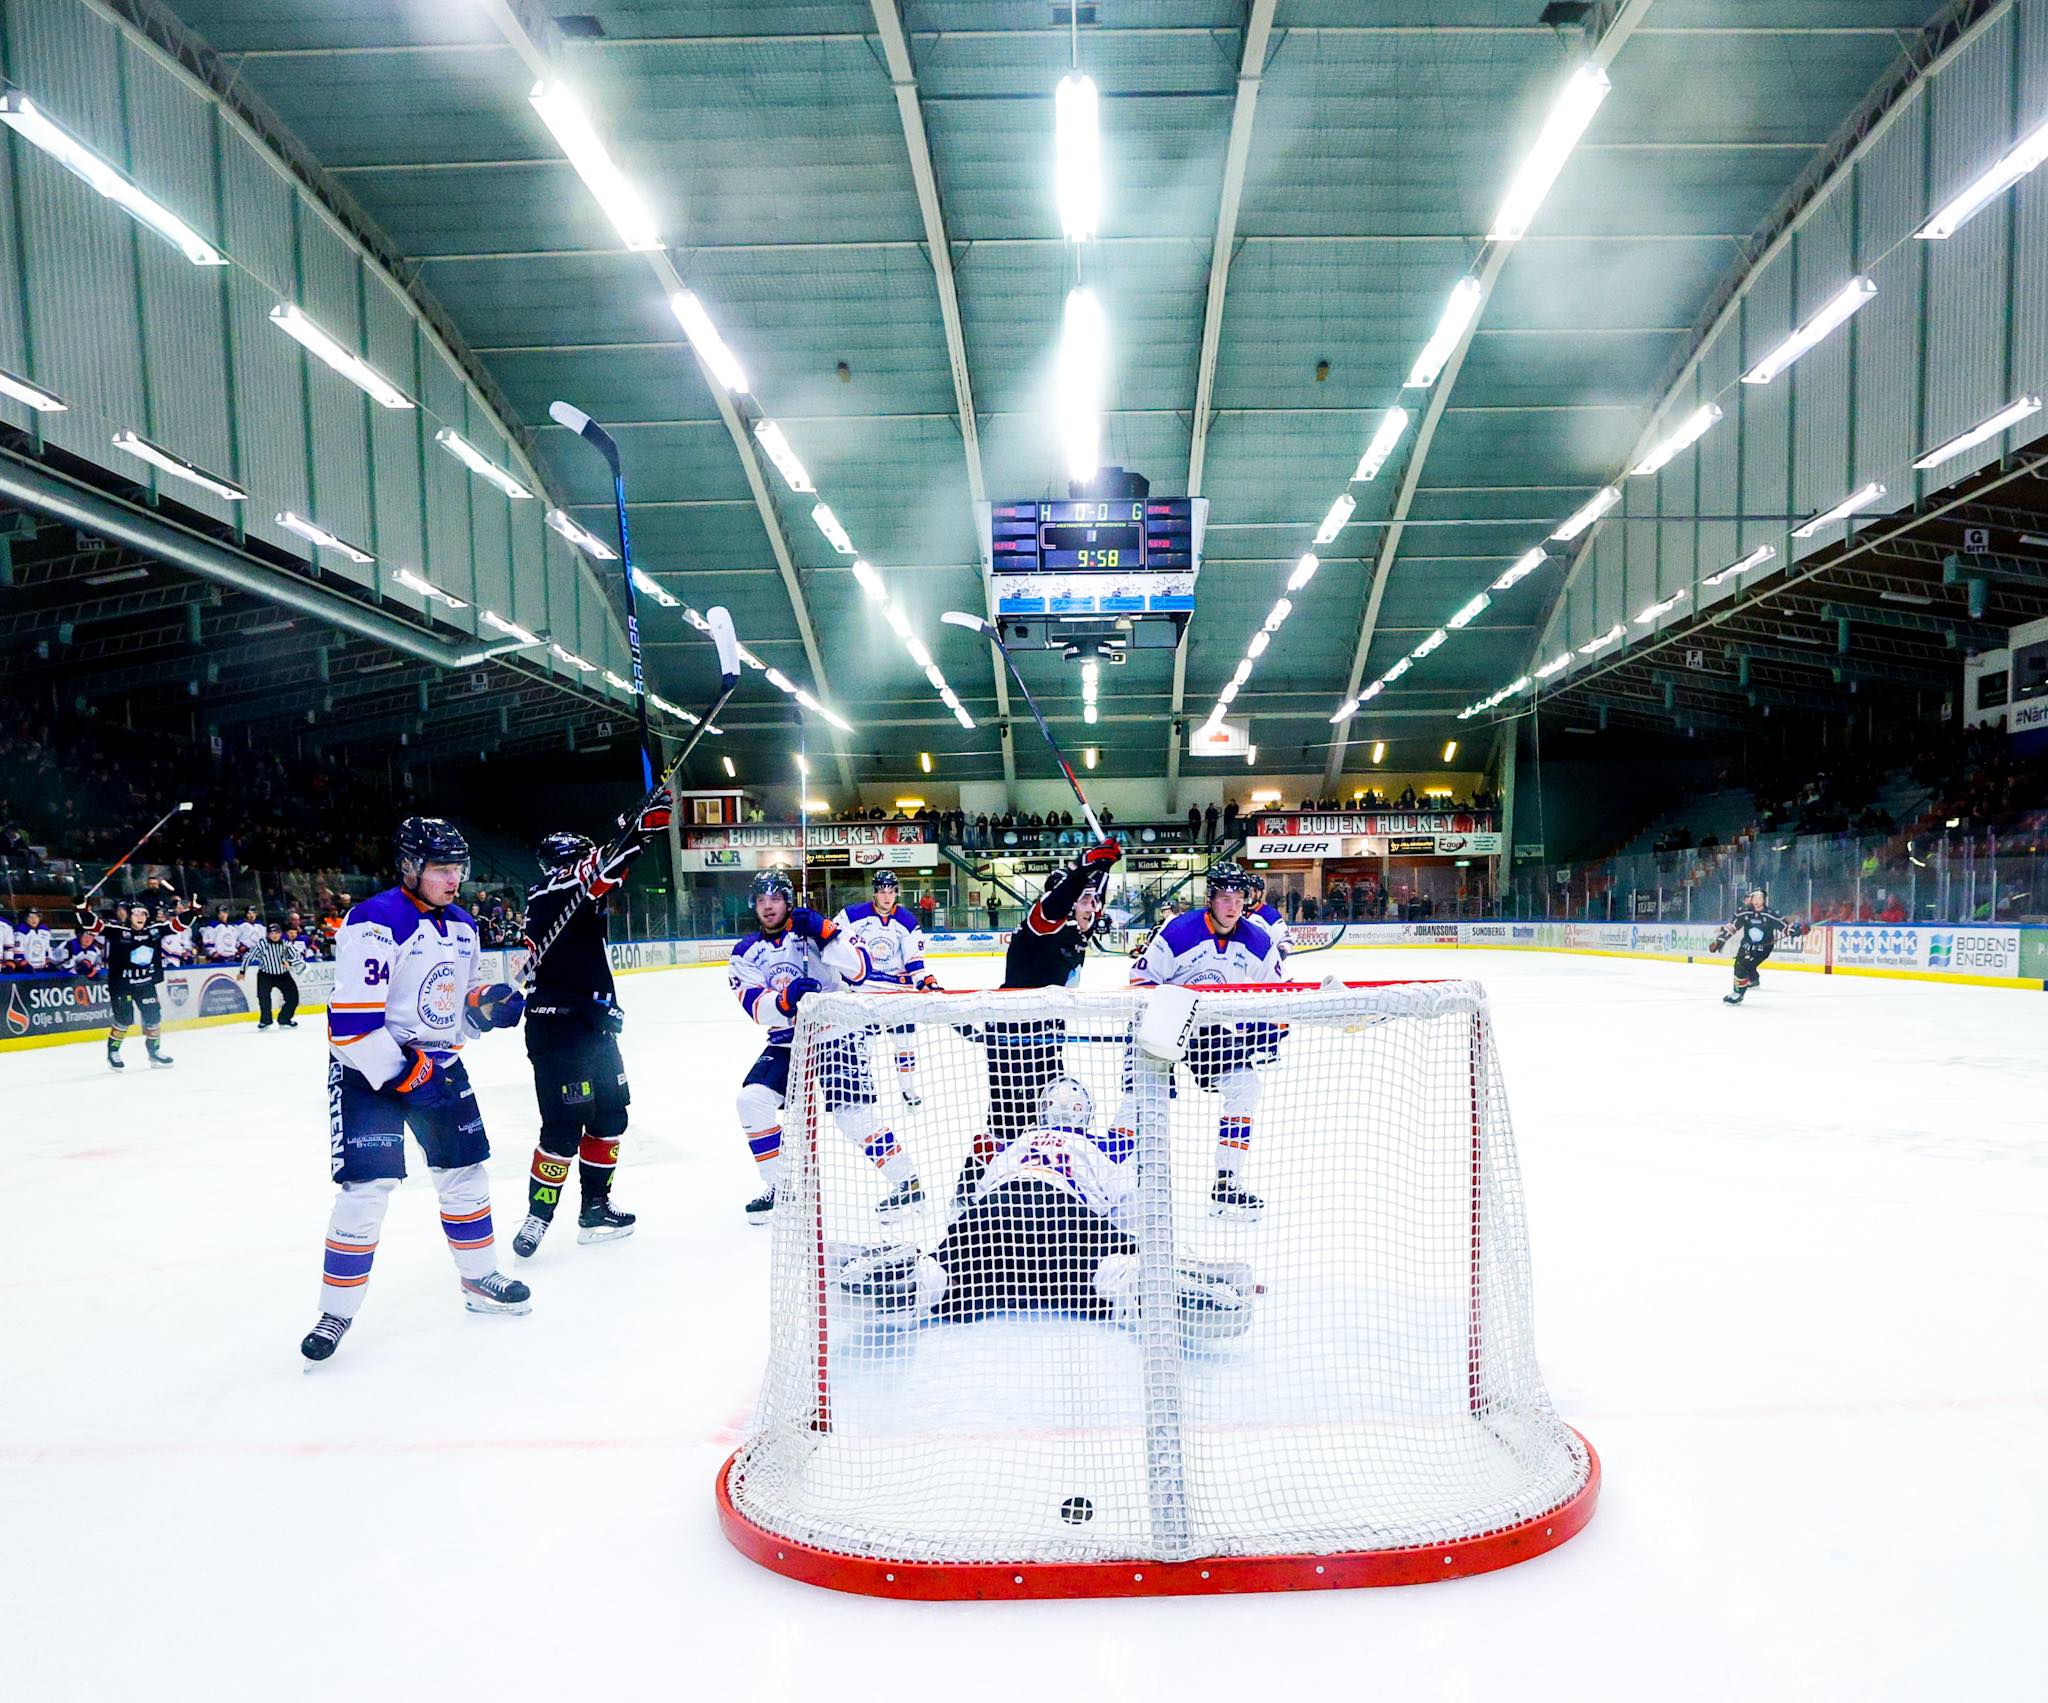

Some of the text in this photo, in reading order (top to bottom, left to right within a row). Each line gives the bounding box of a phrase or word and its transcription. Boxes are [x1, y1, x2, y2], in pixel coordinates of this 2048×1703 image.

[1078, 549, 1119, 568] 9:58
[1299, 814, 1455, 835] BODEN HOCKEY
[728, 828, 797, 848] BODEN
[806, 825, 887, 847] HOCKEY
[1058, 830, 1130, 844] AREA
[1259, 842, 1330, 854] BAUER
[1028, 863, 1049, 872] Kiosk
[1138, 861, 1160, 869] Kiosk
[1413, 925, 1458, 936] JOHANSSONS
[1472, 926, 1506, 936] SUNDBERGS
[1838, 935, 1875, 950] NMK
[1878, 935, 1918, 950] NMK
[1956, 936, 2016, 952] BODENS
[1956, 952, 2008, 967] ENERGI
[364, 958, 390, 986] 34
[32, 1012, 53, 1027] Olje
[54, 1011, 63, 1024] &
[64, 1008, 108, 1022] Transport
[328, 1085, 345, 1177] STENA
